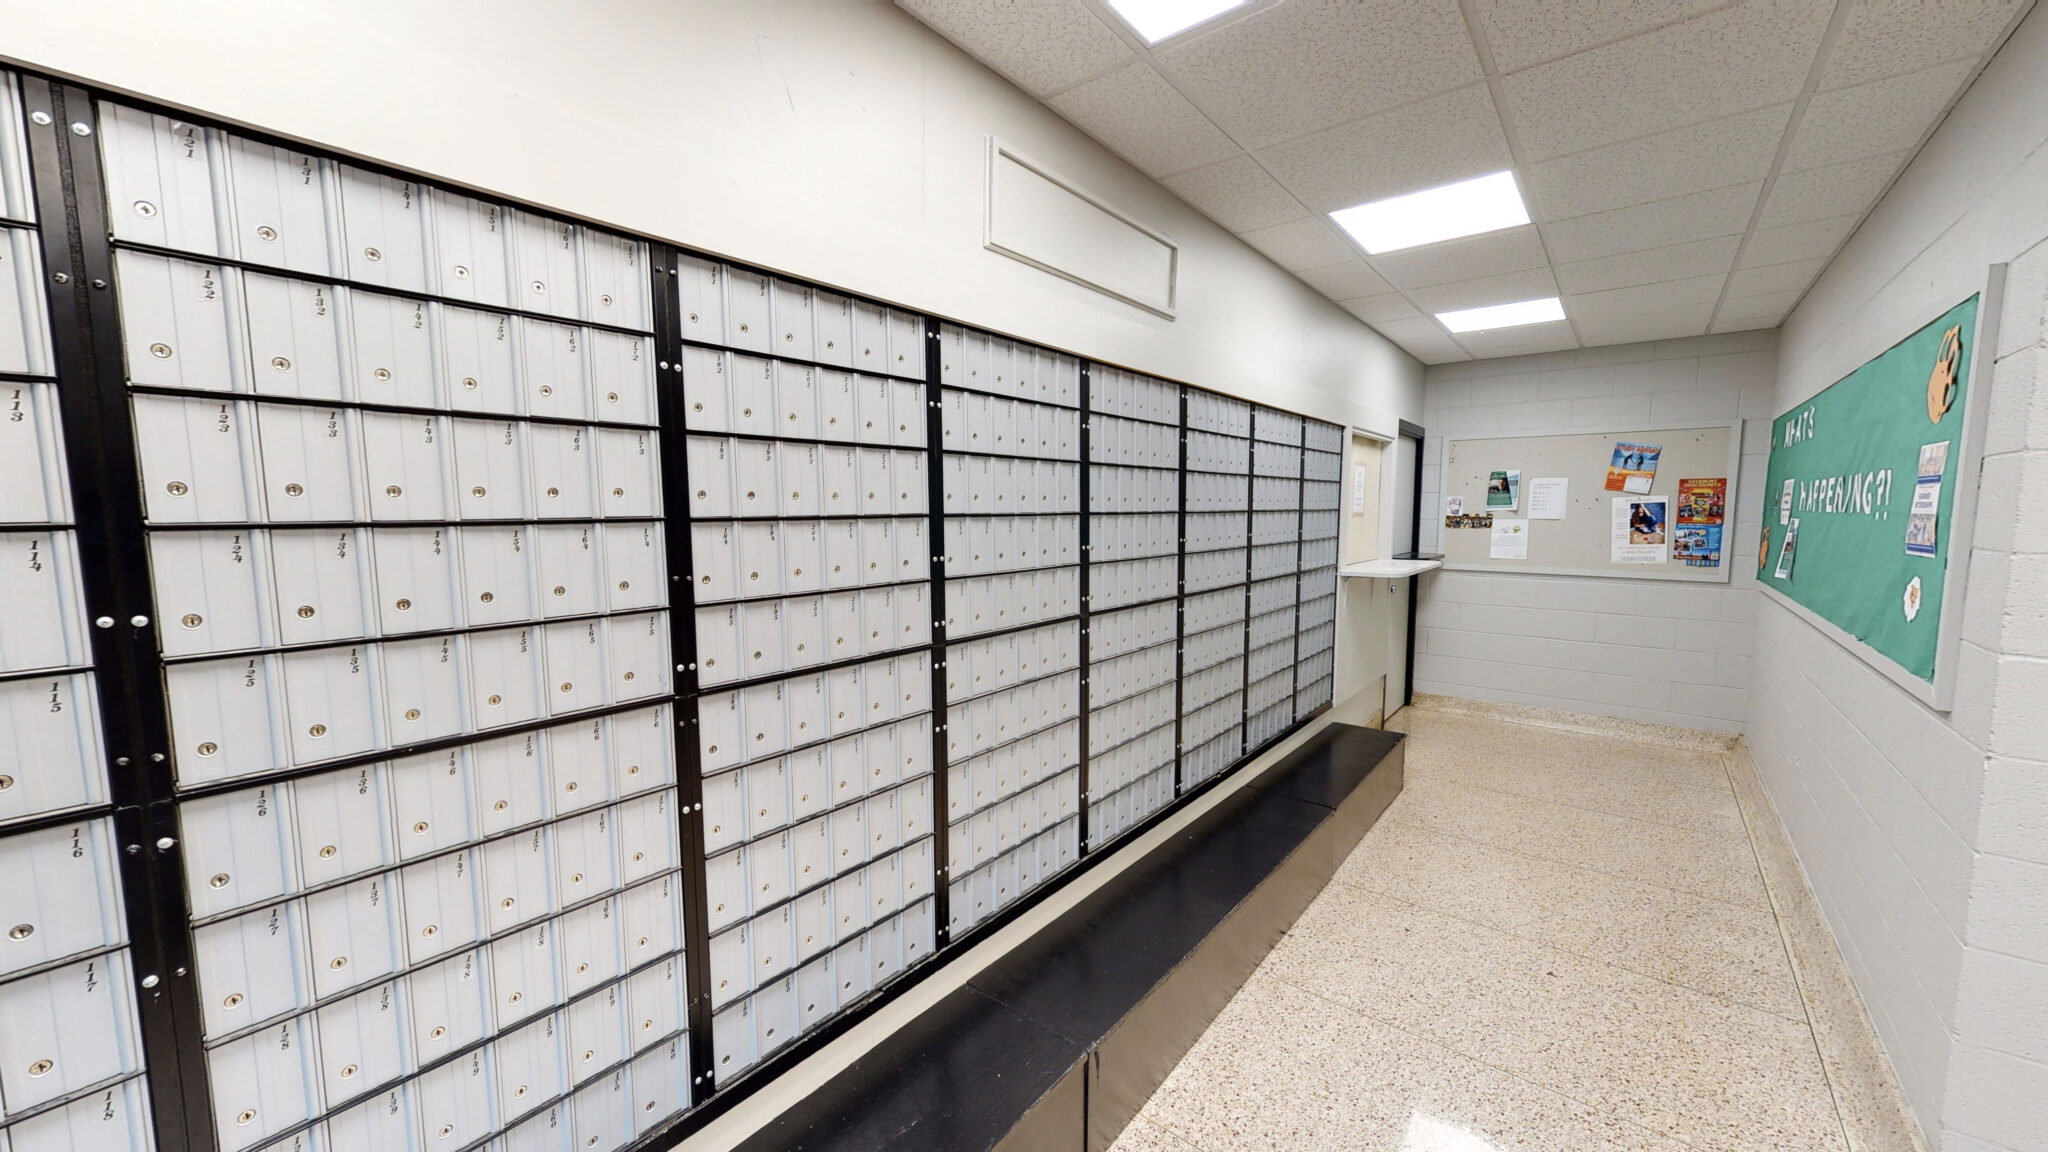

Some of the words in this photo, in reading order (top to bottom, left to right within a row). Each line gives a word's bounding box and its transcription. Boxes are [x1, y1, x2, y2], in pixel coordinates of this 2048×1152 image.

[184, 127, 195, 158] 121
[302, 157, 311, 185] 131
[203, 270, 215, 299] 122
[316, 288, 325, 315] 132
[11, 390, 23, 422] 113
[218, 404, 230, 432] 123
[328, 412, 338, 437] 133
[1783, 405, 1816, 449] WHAT'S
[29, 541, 42, 571] 114
[232, 536, 242, 563] 124
[338, 533, 346, 558] 134
[245, 660, 255, 687] 125
[350, 648, 359, 673] 135
[50, 682, 62, 712] 115
[358, 770, 367, 794] 136
[257, 790, 267, 816] 126
[72, 828, 83, 857] 116
[370, 882, 379, 906] 137
[270, 908, 279, 936] 127
[86, 962, 97, 992] 117
[381, 986, 389, 1011] 138
[281, 1024, 290, 1050] 128
[103, 1091, 114, 1120] 118
